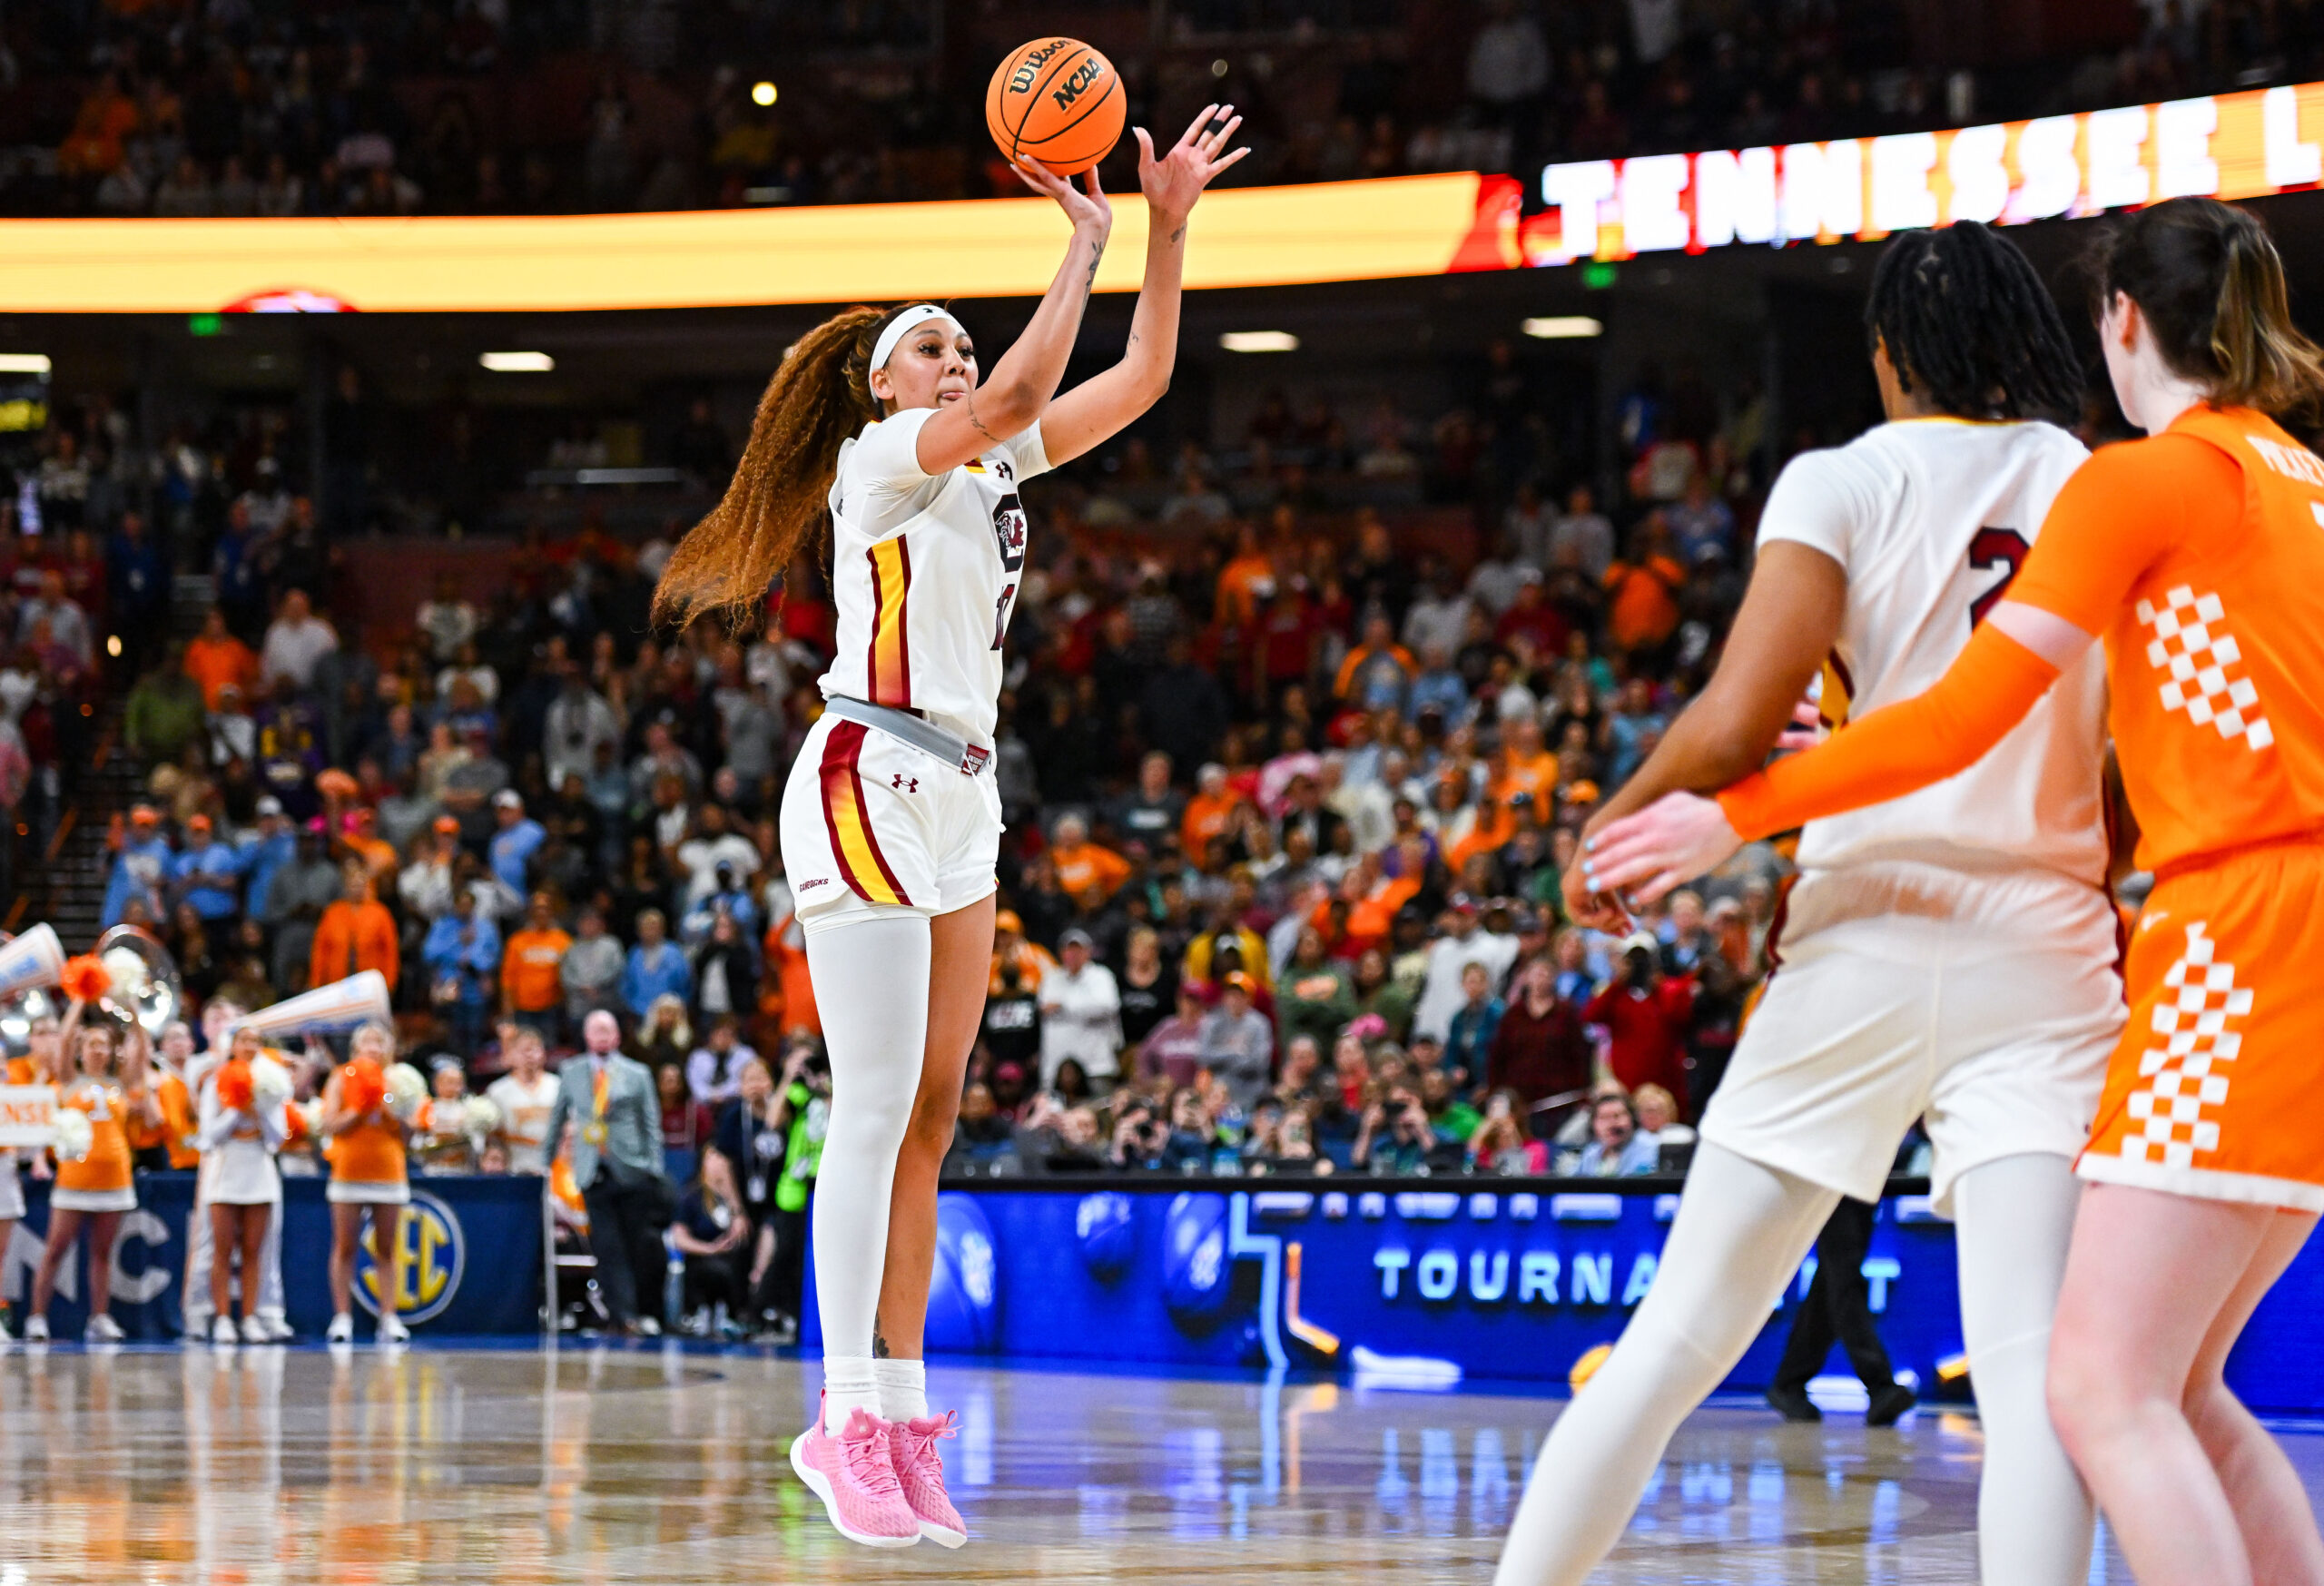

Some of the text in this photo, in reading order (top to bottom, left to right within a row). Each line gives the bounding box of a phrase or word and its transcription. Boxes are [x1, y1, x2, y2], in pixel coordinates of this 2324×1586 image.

[1051, 56, 1105, 112] NCAA
[1541, 94, 2219, 258] TENNESSEE
[1373, 1247, 1903, 1314] TOURNAT
